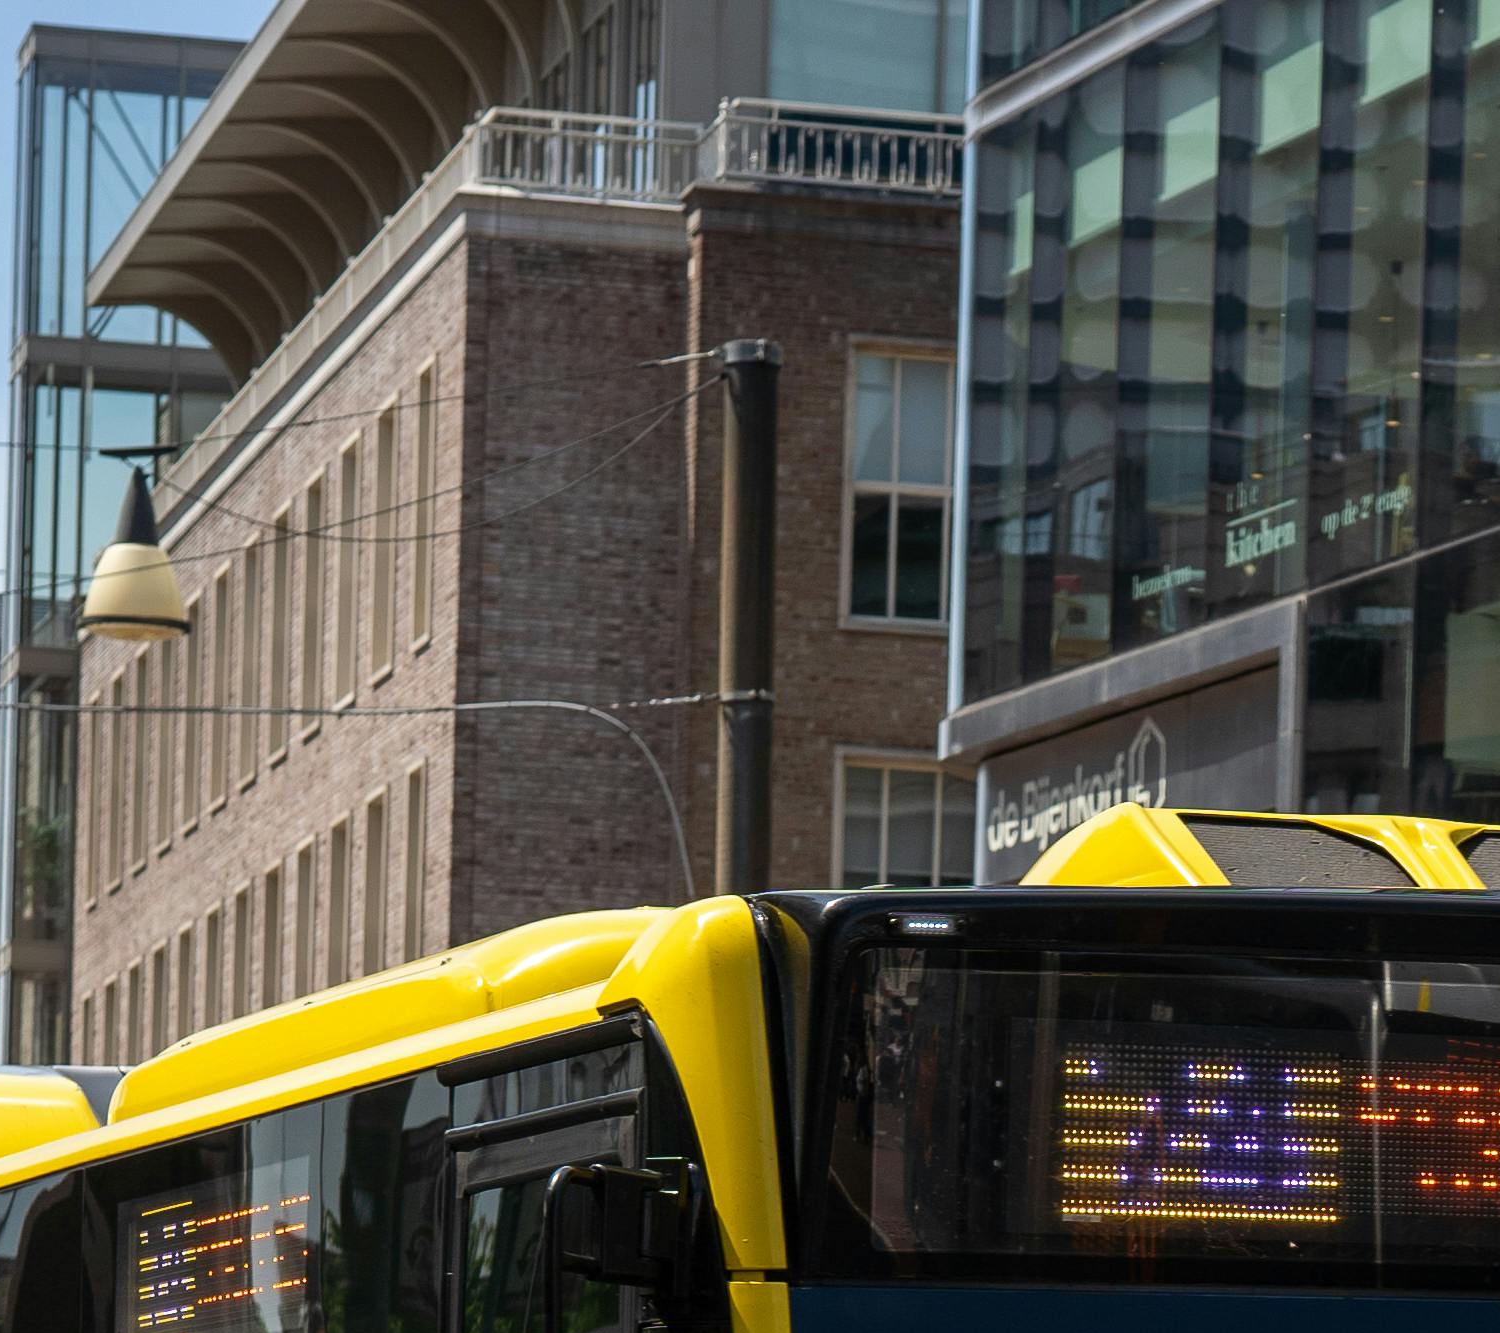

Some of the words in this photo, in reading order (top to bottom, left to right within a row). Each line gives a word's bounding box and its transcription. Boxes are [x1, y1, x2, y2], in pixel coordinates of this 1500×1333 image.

[1225, 518, 1296, 568] kitchen
[987, 790, 1020, 851] de
[1020, 752, 1125, 851] Bijenkorf
